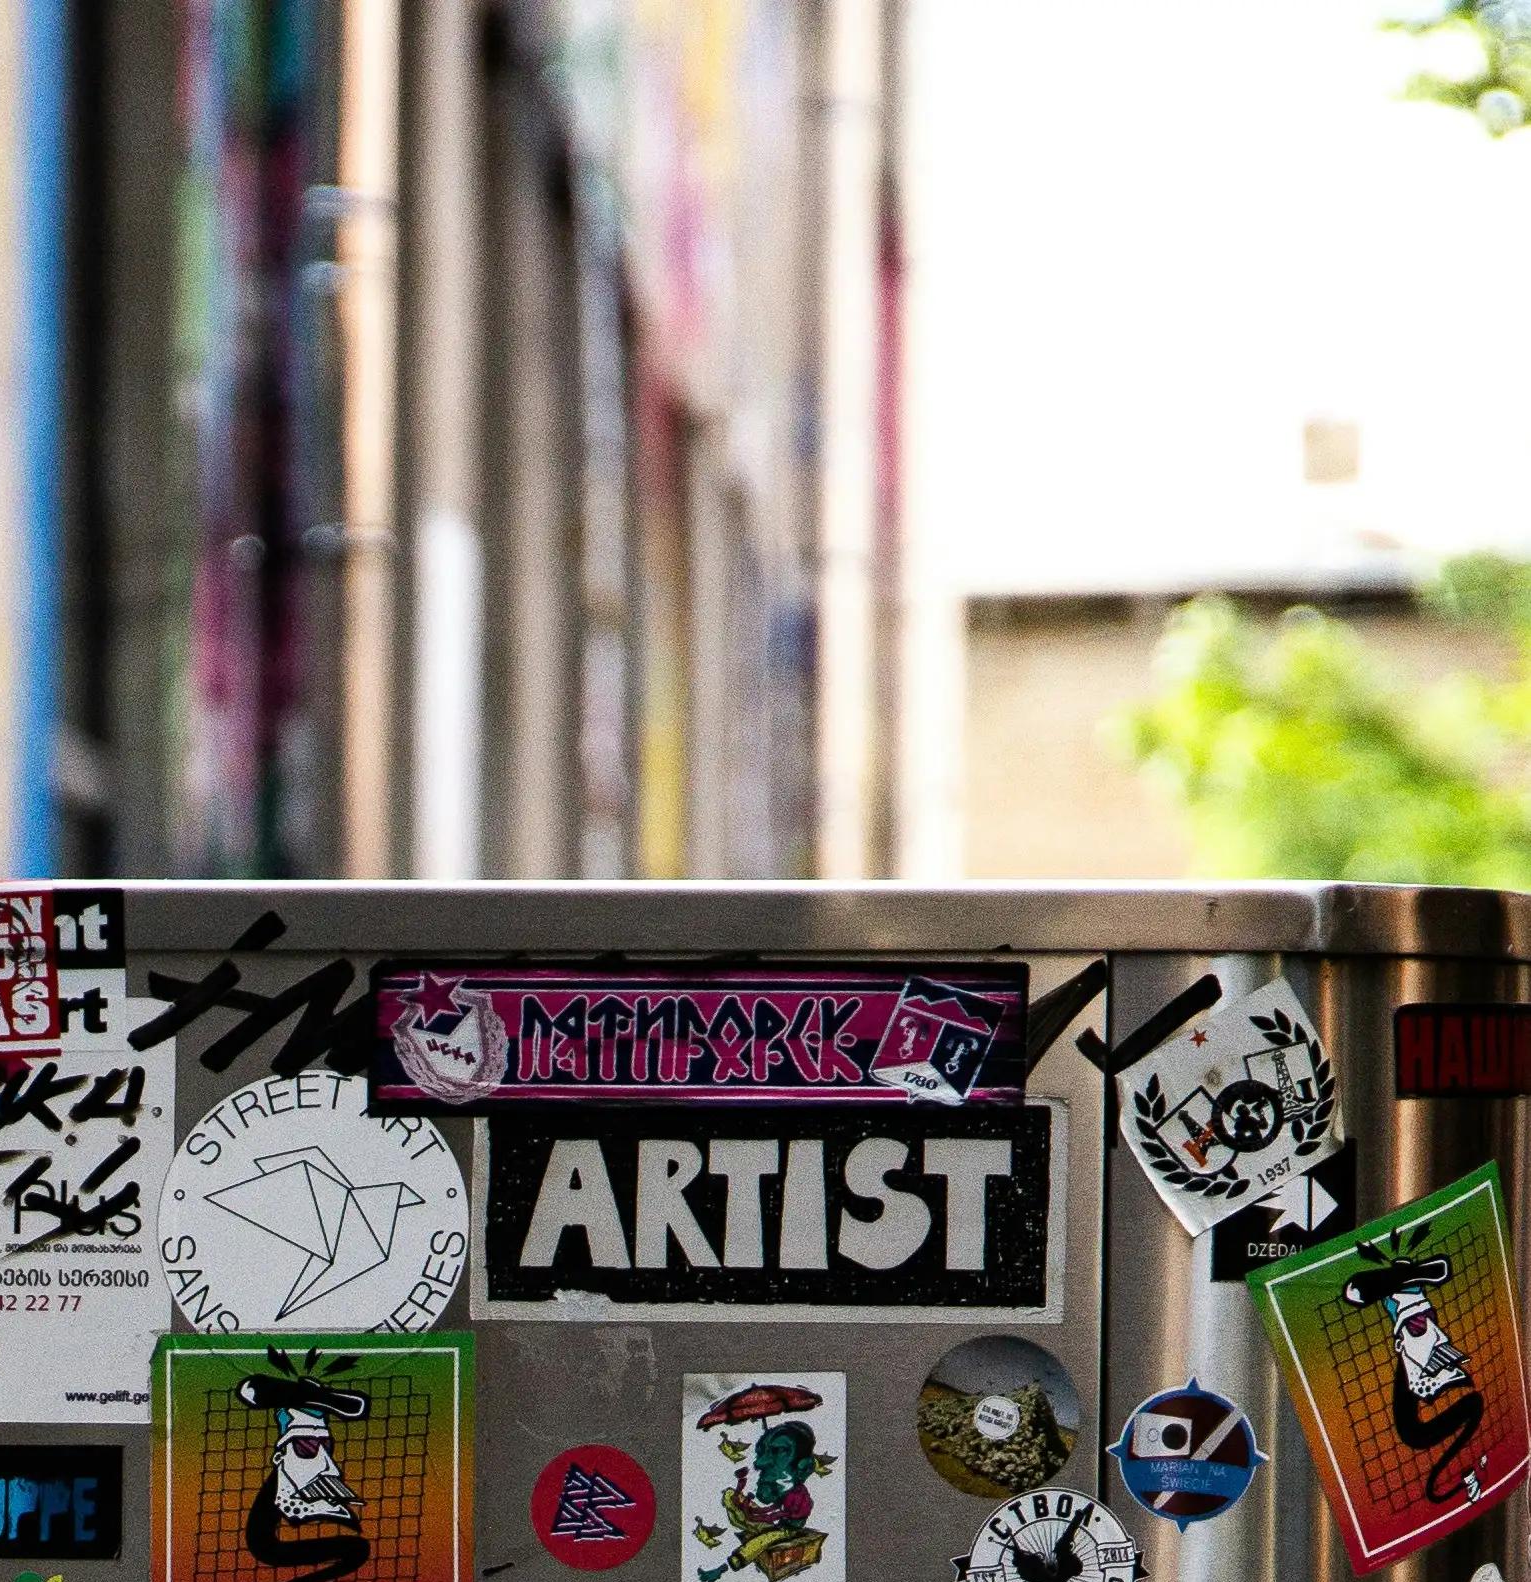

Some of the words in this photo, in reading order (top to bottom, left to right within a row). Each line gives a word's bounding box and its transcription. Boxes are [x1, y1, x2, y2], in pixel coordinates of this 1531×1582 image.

[902, 1070, 939, 1092] 1780
[185, 1074, 353, 1166] STREET
[1256, 1156, 1293, 1186] 1937
[518, 1138, 1013, 1272] ARTIST
[25, 1295, 50, 1312] 22
[57, 1295, 82, 1312] 77
[1150, 1460, 1202, 1477] MARIAN
[1209, 1464, 1227, 1478] NA
